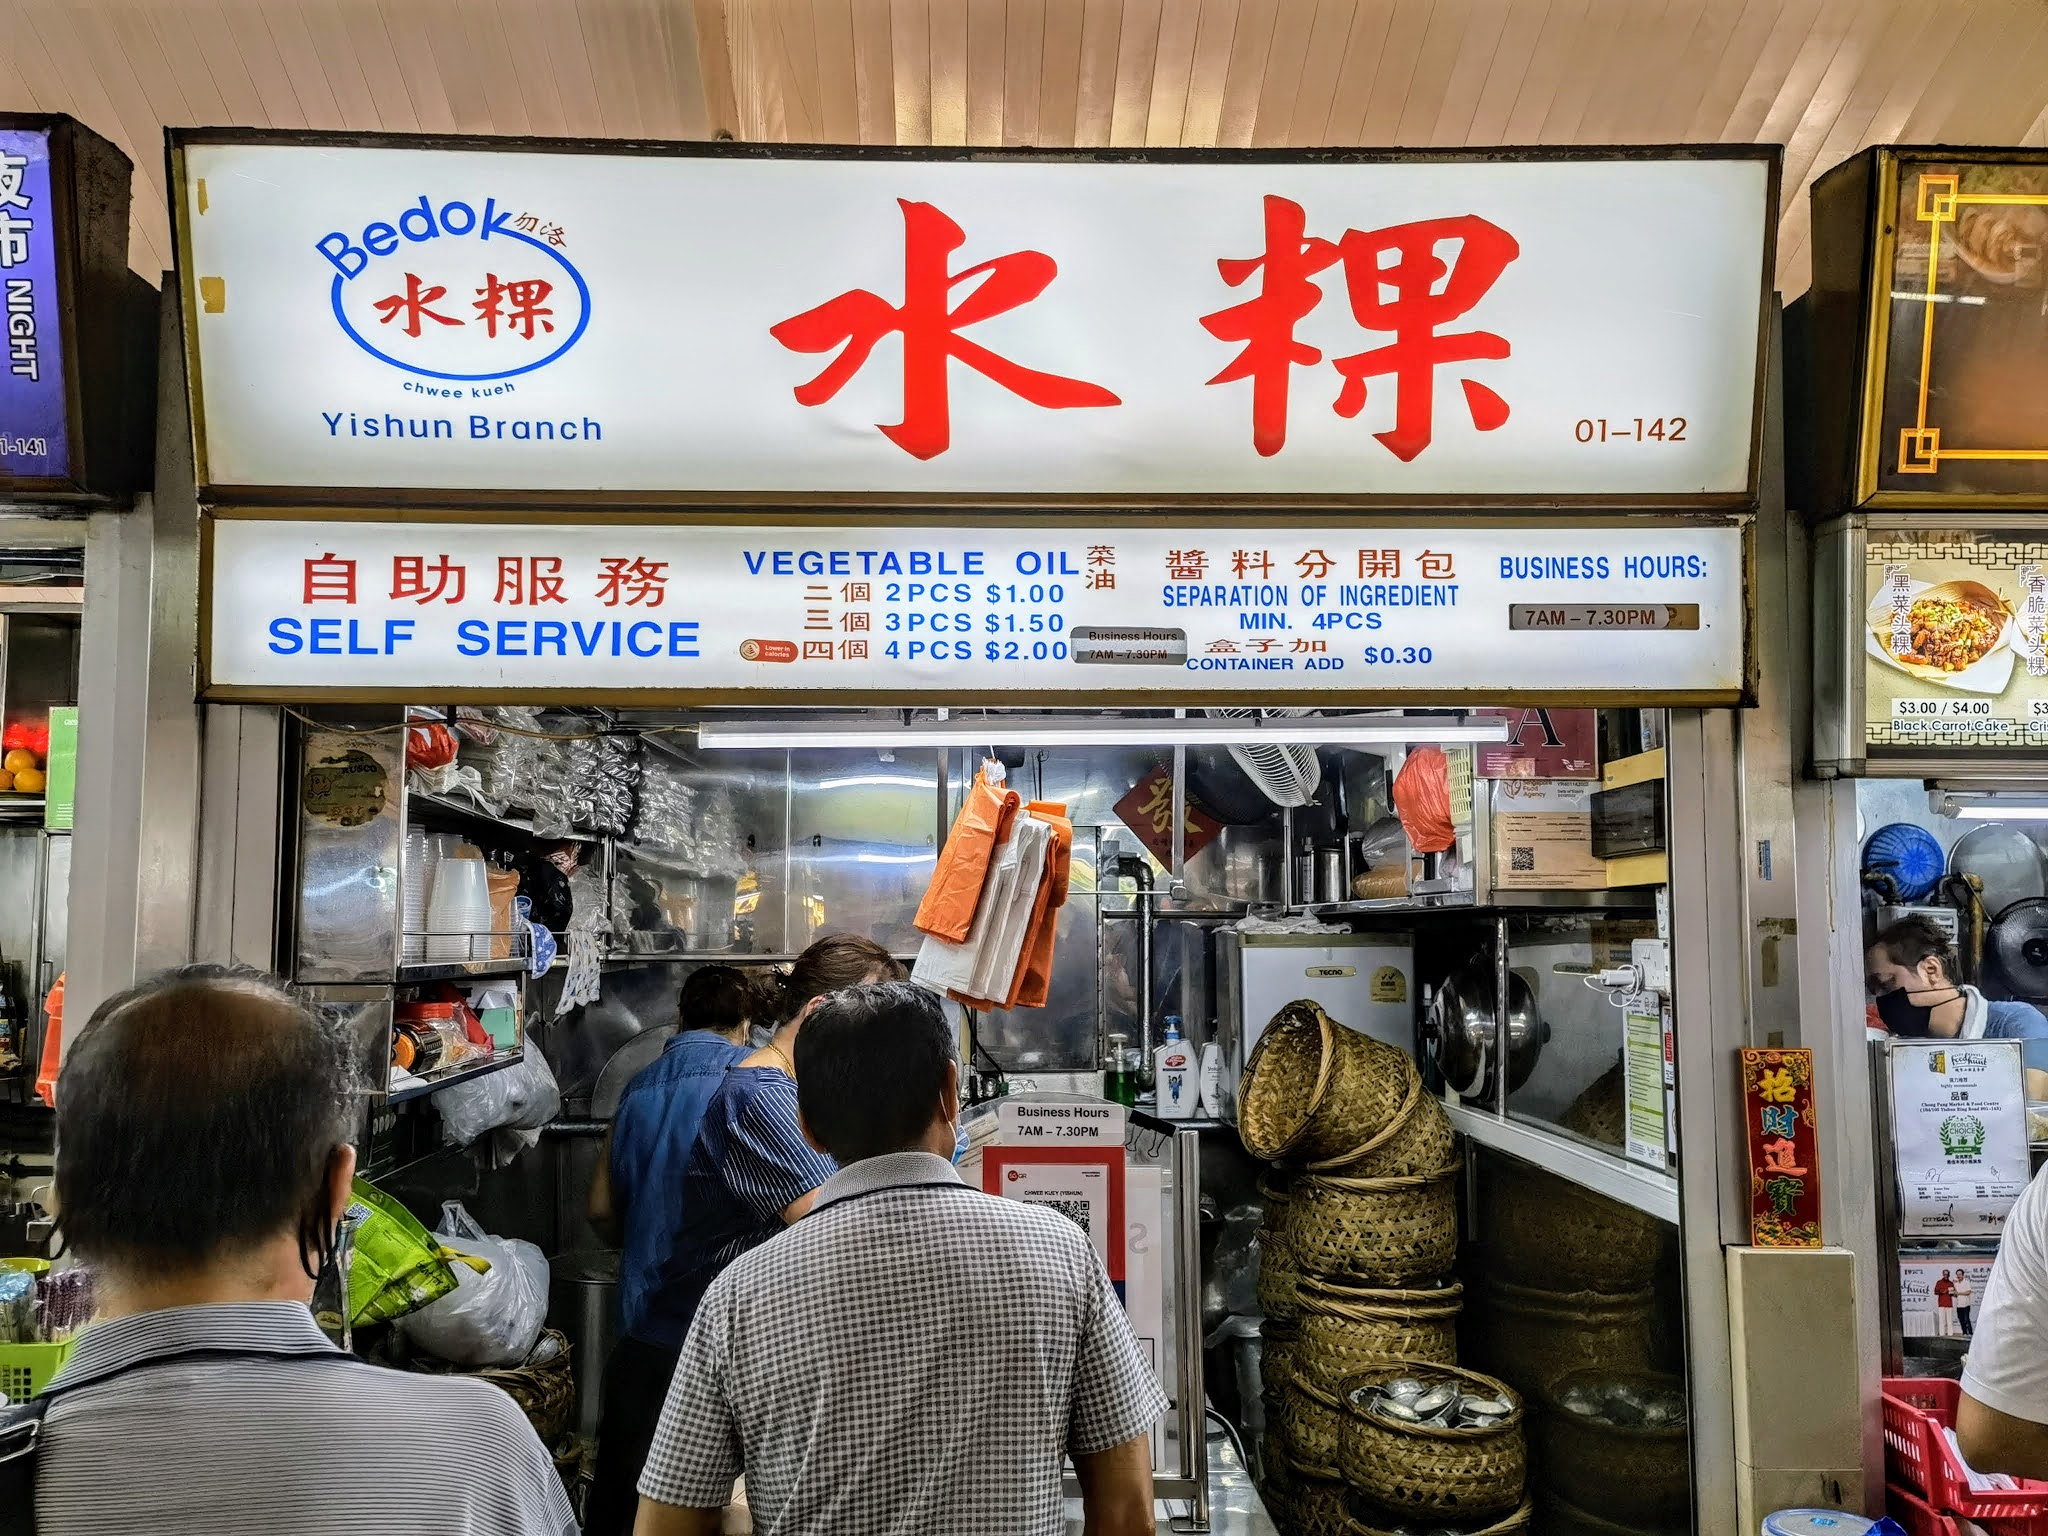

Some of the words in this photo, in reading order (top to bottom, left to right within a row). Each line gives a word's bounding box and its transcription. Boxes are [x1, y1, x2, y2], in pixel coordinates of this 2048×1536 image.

[315, 195, 512, 281] Bedok
[514, 212, 567, 248] 勿洛
[373, 272, 555, 341] 水粿
[6, 279, 38, 381] NIGHT
[770, 195, 1520, 462] 水粿
[403, 380, 463, 399] chwee
[471, 381, 516, 398] kueh
[322, 412, 453, 439] Yishun
[470, 415, 602, 441] Branch
[744, 551, 985, 576] VEGETABLE
[1015, 551, 1080, 576] OIL
[1165, 548, 1457, 581] 醬料分開包
[1500, 555, 1611, 580] BUSINESS
[1624, 555, 1707, 579] HOURS:
[303, 552, 669, 608] 自助服務
[804, 582, 871, 603] 二個
[986, 583, 1064, 604] $1.00
[1162, 585, 1288, 607] SEPARATION
[1301, 585, 1327, 607] OF
[1339, 585, 1460, 607] INGREDIENT
[804, 609, 871, 633] 三個
[985, 613, 1064, 634] $1.50
[1239, 612, 1293, 630] MIN.
[1311, 612, 1383, 630] 4PCS
[1526, 610, 1565, 625] 7AM
[1586, 609, 1656, 626] 7.30PM
[1892, 574, 1911, 654] 黑菜头粿
[1089, 631, 1140, 641] Business
[1143, 631, 1177, 641] Hours
[2028, 575, 2047, 676] 香脆菜头粿
[268, 617, 415, 656] SELF
[457, 619, 701, 658] SERVICE
[1205, 638, 1328, 654] 盒子加
[803, 639, 869, 661] 四個
[985, 640, 1068, 661] $2.00
[1090, 650, 1114, 660] 7AM
[1126, 650, 1168, 660] 7.30PM
[1186, 657, 1294, 671] CONTAINER
[1305, 657, 1345, 671] ADD
[1364, 646, 1433, 665] $0.30
[1899, 701, 1936, 715] $3.00
[1952, 701, 1990, 715] $4.00
[1893, 720, 1928, 731] Black
[1932, 720, 1971, 731] Carrot
[1974, 720, 2009, 731] Cake
[2029, 720, 2048, 732] Cri
[1017, 1106, 1071, 1118] Business
[1073, 1107, 1110, 1118] Hours
[1017, 1126, 1044, 1137] 7AM
[1055, 1126, 1099, 1137] 7.30PM
